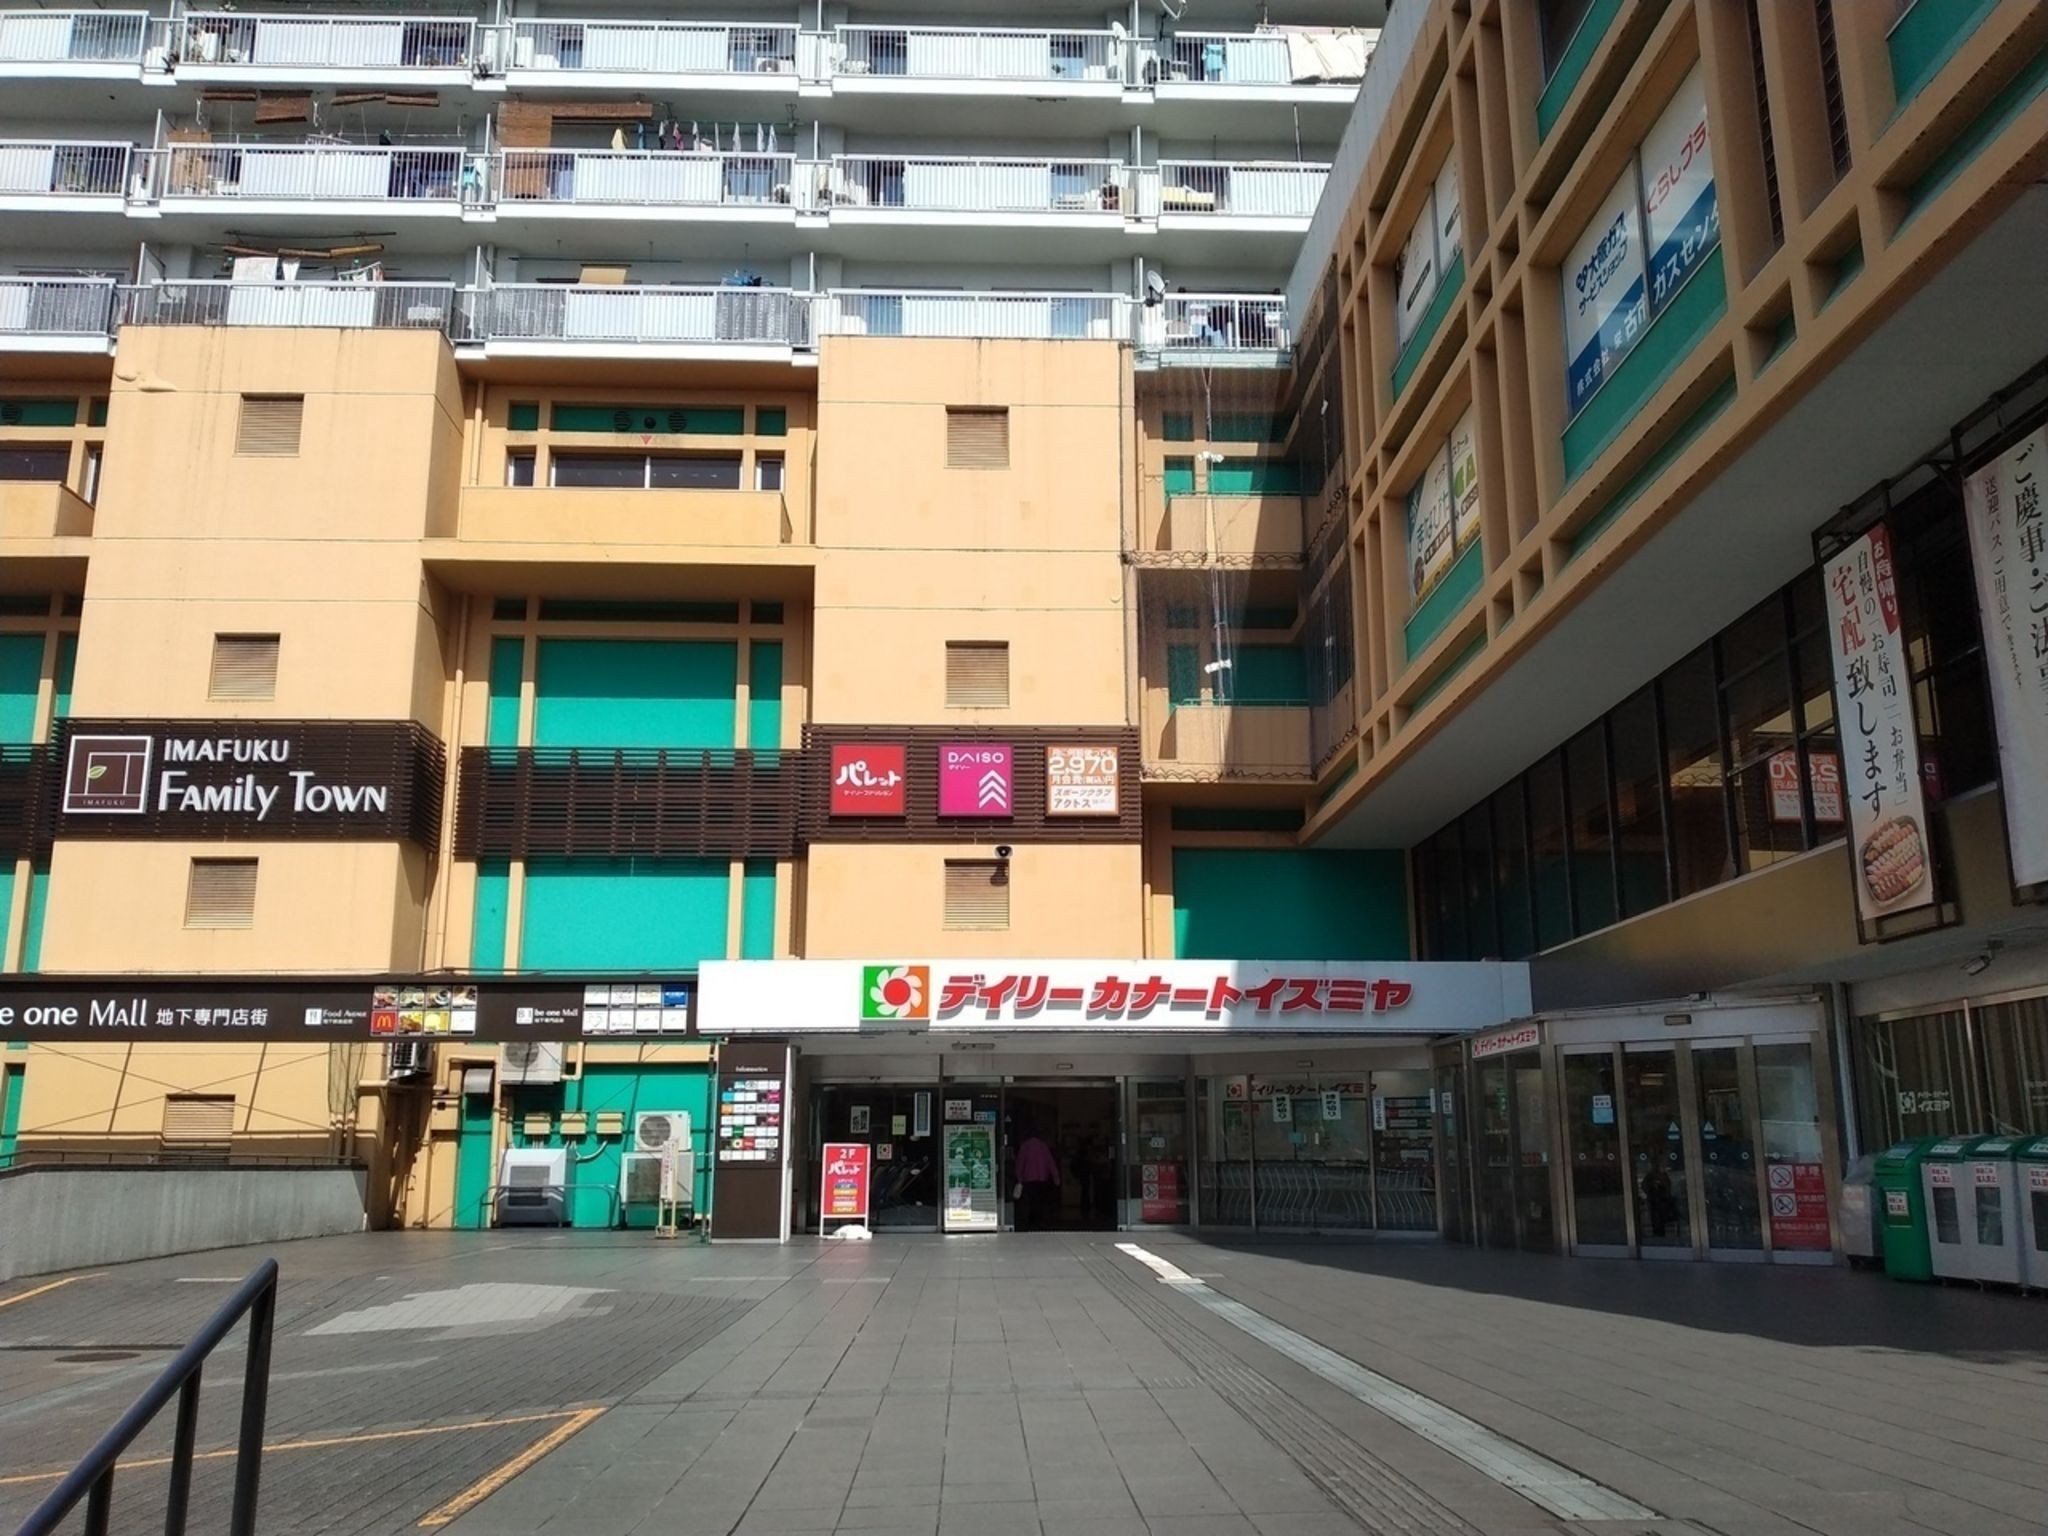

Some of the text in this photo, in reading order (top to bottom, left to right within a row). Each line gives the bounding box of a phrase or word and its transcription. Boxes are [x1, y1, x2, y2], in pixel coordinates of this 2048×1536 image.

[164, 738, 290, 763] IMAFUKU
[948, 752, 1004, 763] DAISO
[835, 760, 902, 787] パレット
[1048, 756, 1118, 776] 2,970
[937, 974, 1413, 1022] デイリーカナートイズミヤ
[23, 1006, 79, 1026] one
[155, 1007, 269, 1027] 地下専門店街
[840, 1148, 856, 1159] 2F
